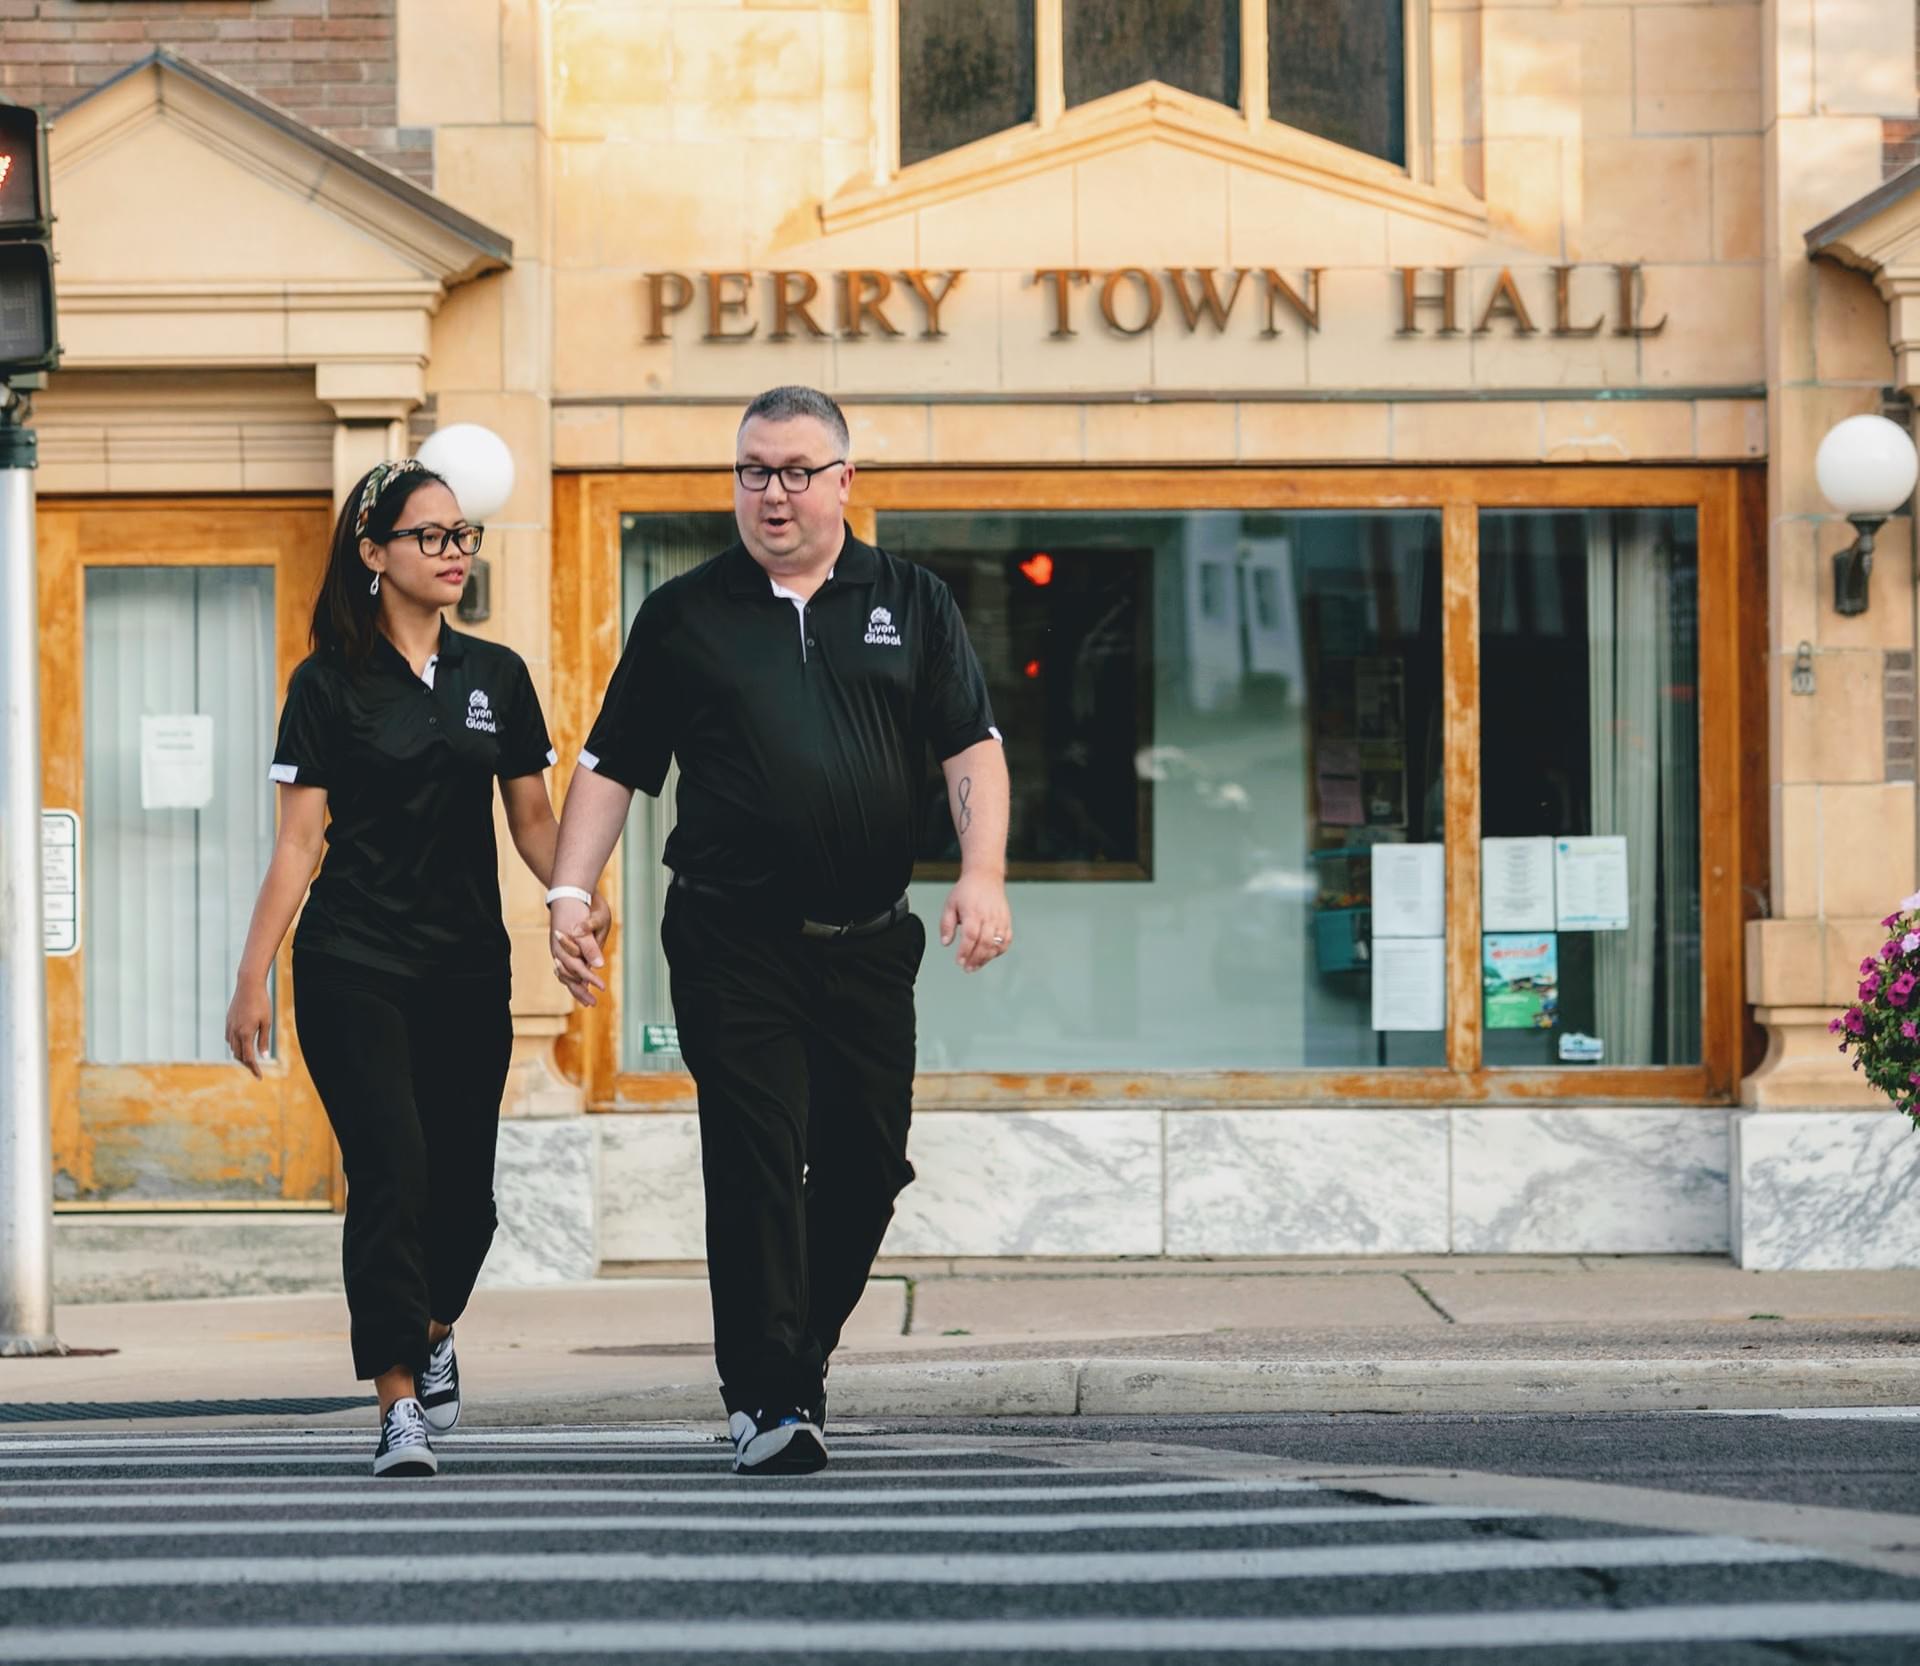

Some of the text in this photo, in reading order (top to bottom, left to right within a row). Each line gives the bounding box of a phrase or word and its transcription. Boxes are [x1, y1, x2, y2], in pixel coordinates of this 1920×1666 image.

[642, 263, 1667, 342] PERRY TOWN HALL
[868, 622, 896, 635] Lyon
[864, 633, 902, 646] Global
[468, 706, 493, 720] Lyon
[465, 717, 497, 733] Global
